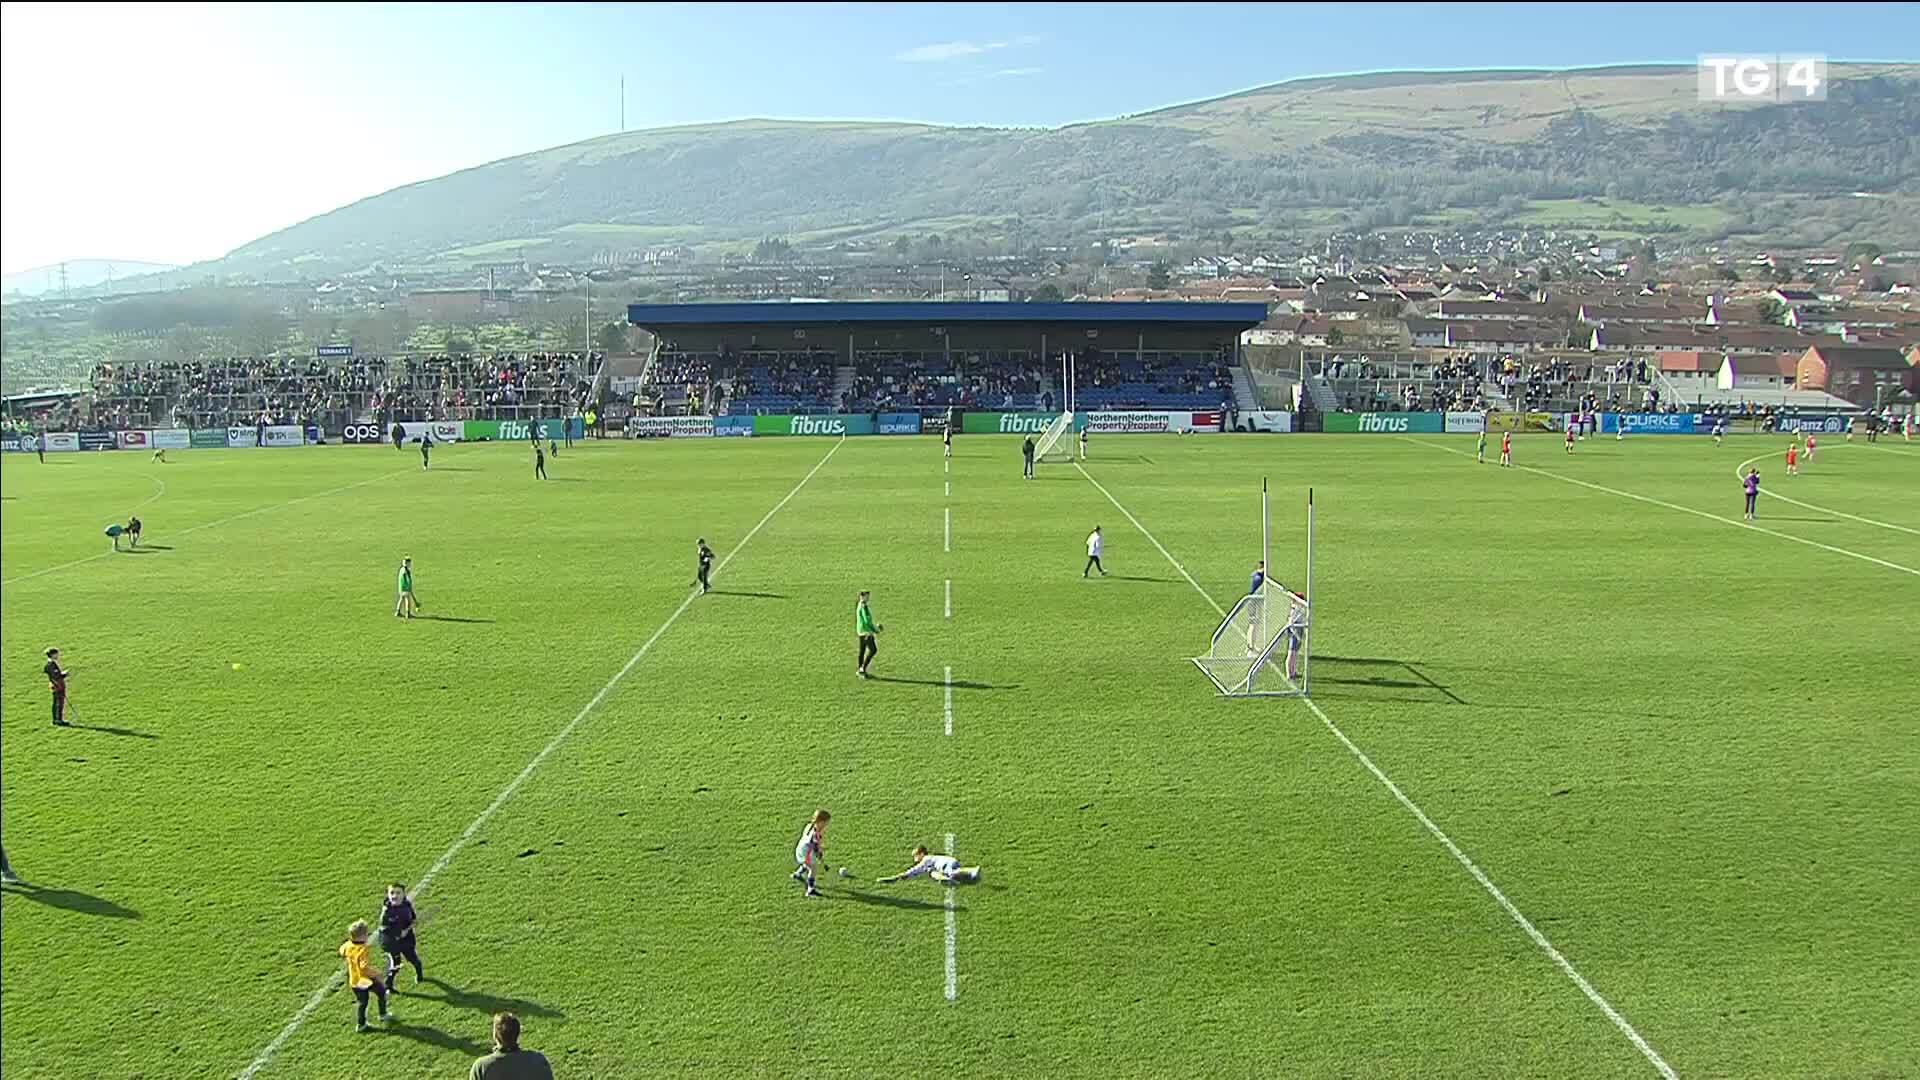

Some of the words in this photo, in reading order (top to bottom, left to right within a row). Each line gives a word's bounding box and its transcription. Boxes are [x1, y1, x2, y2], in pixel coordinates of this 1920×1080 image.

[1088, 413, 1127, 421] Northern
[1128, 413, 1169, 421] Northern
[1358, 413, 1408, 431] fibrus
[499, 421, 548, 439] fibrs
[672, 425, 713, 434] Property
[790, 416, 842, 434] fibrus
[1088, 422, 1127, 430] Property
[1128, 421, 1169, 430] Property
[1780, 418, 1823, 431] Allianz
[344, 425, 379, 442] ops
